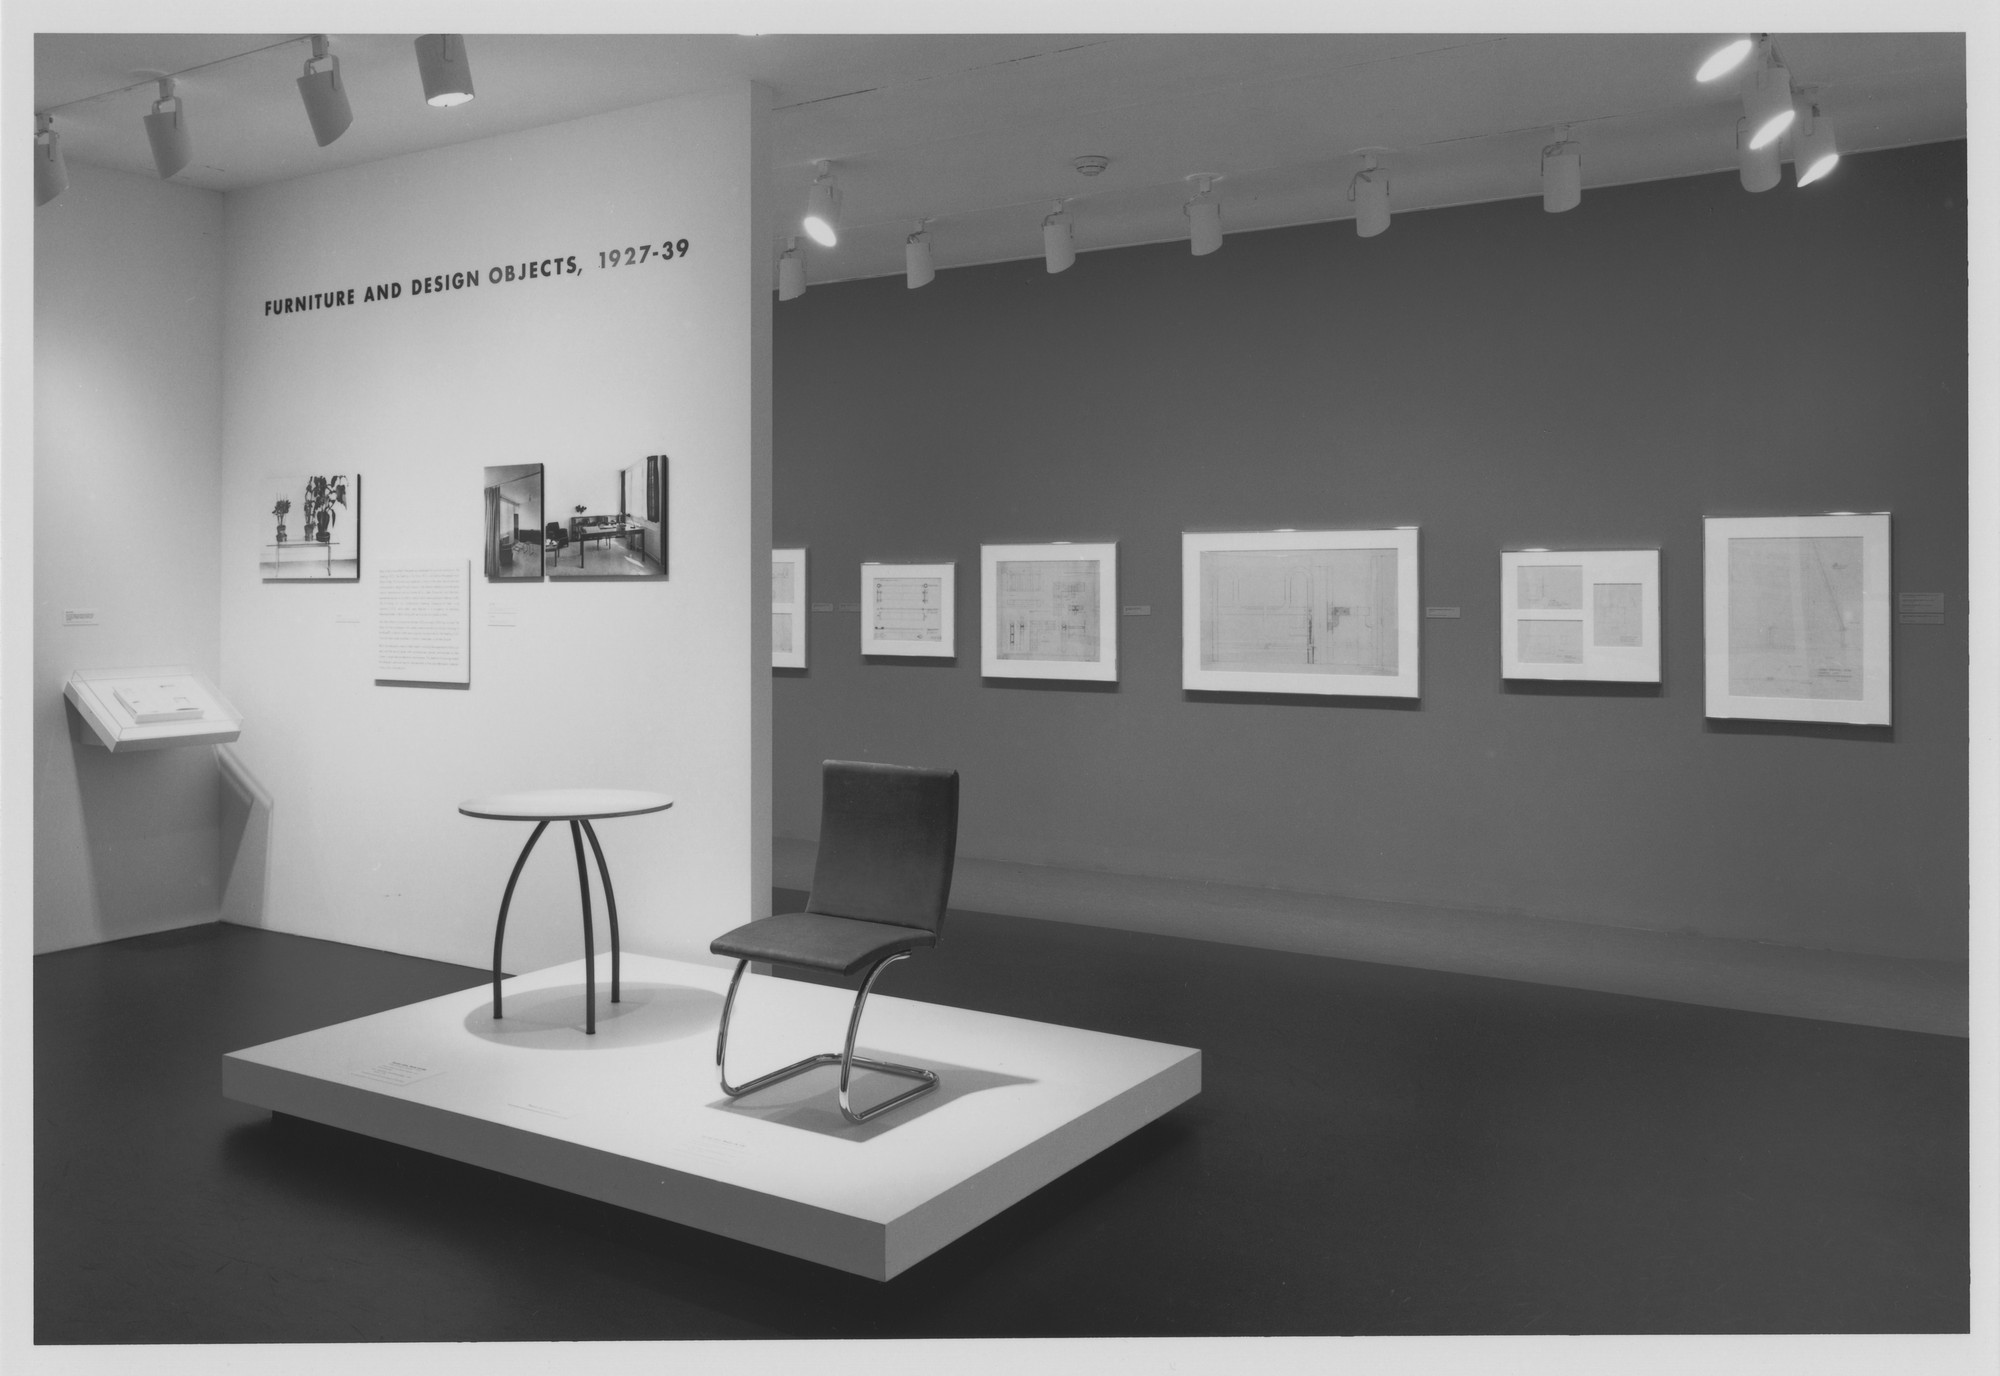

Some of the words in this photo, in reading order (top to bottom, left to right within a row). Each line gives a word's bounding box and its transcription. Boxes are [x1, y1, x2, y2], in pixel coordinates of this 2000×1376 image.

[264, 289, 355, 316] FURNITURE
[363, 282, 402, 303] AND
[411, 270, 480, 296] DESIGN
[488, 256, 583, 285] OBJECTS,
[599, 239, 690, 269] 1927-39
